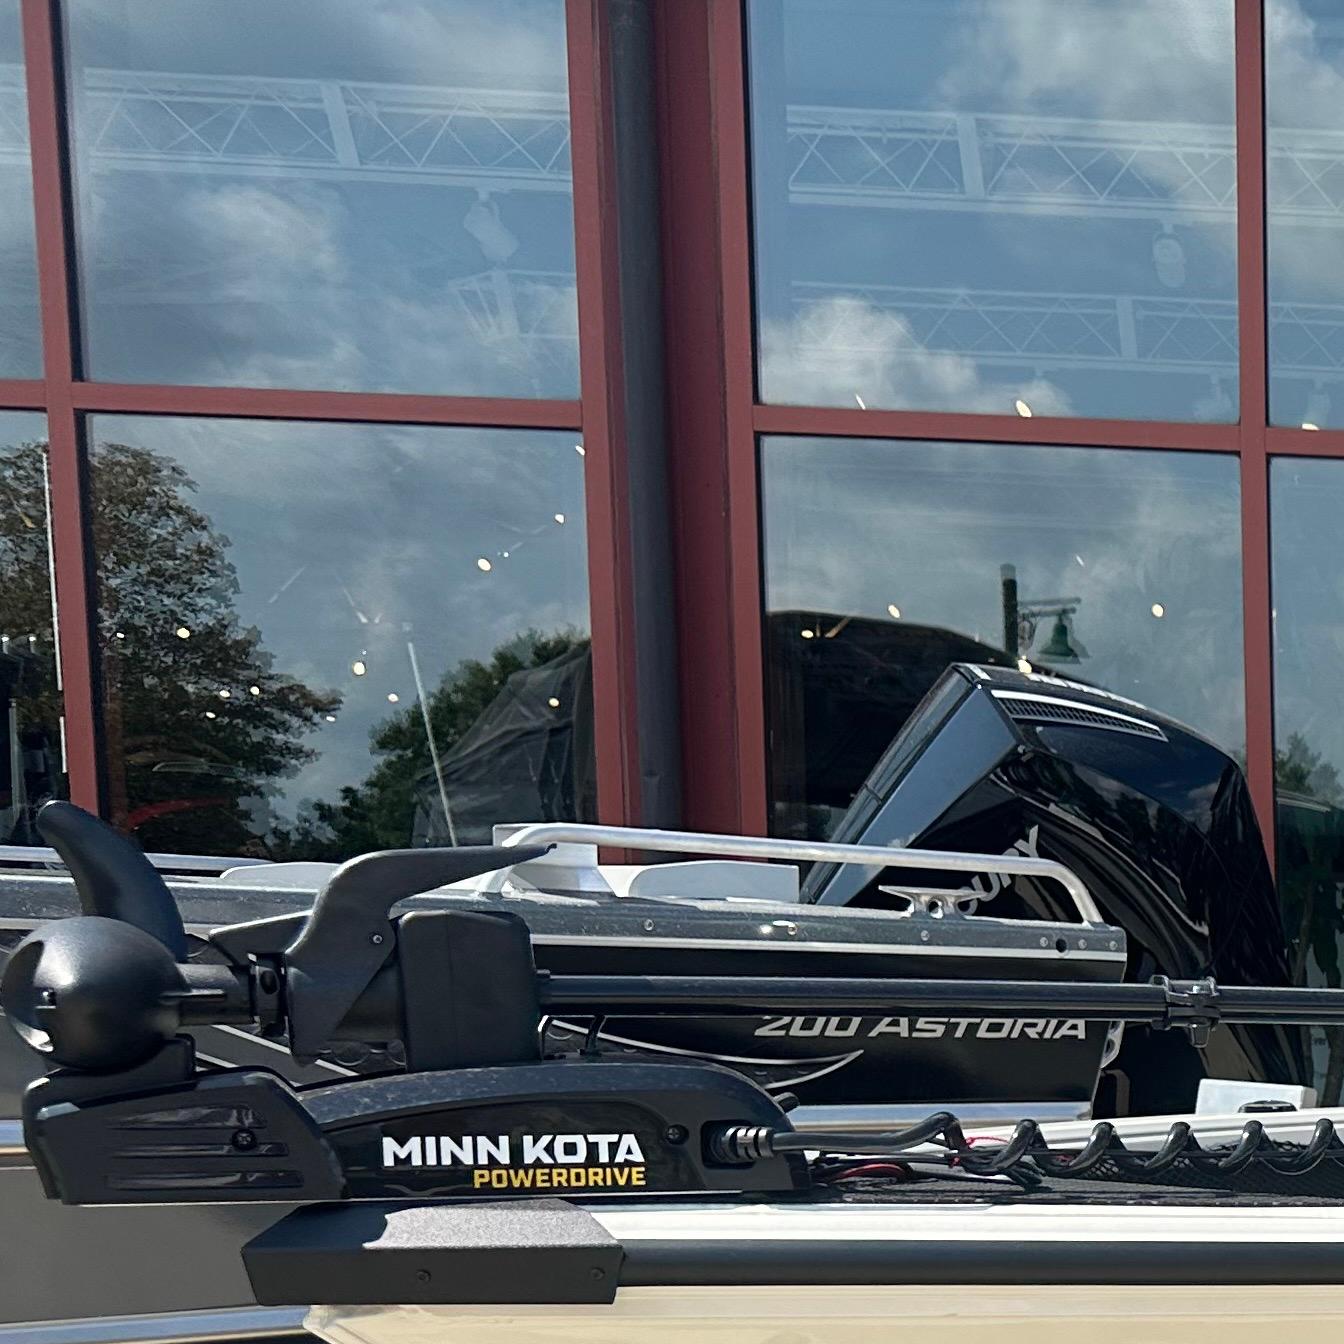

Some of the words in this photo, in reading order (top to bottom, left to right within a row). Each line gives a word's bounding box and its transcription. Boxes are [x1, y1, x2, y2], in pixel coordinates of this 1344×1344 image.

[754, 1015, 864, 1037] 200
[867, 1015, 1087, 1039] ASTORIA
[382, 1135, 511, 1167] MINN
[522, 1133, 646, 1164] KOTA
[473, 1166, 647, 1189] POWERDRIVE
